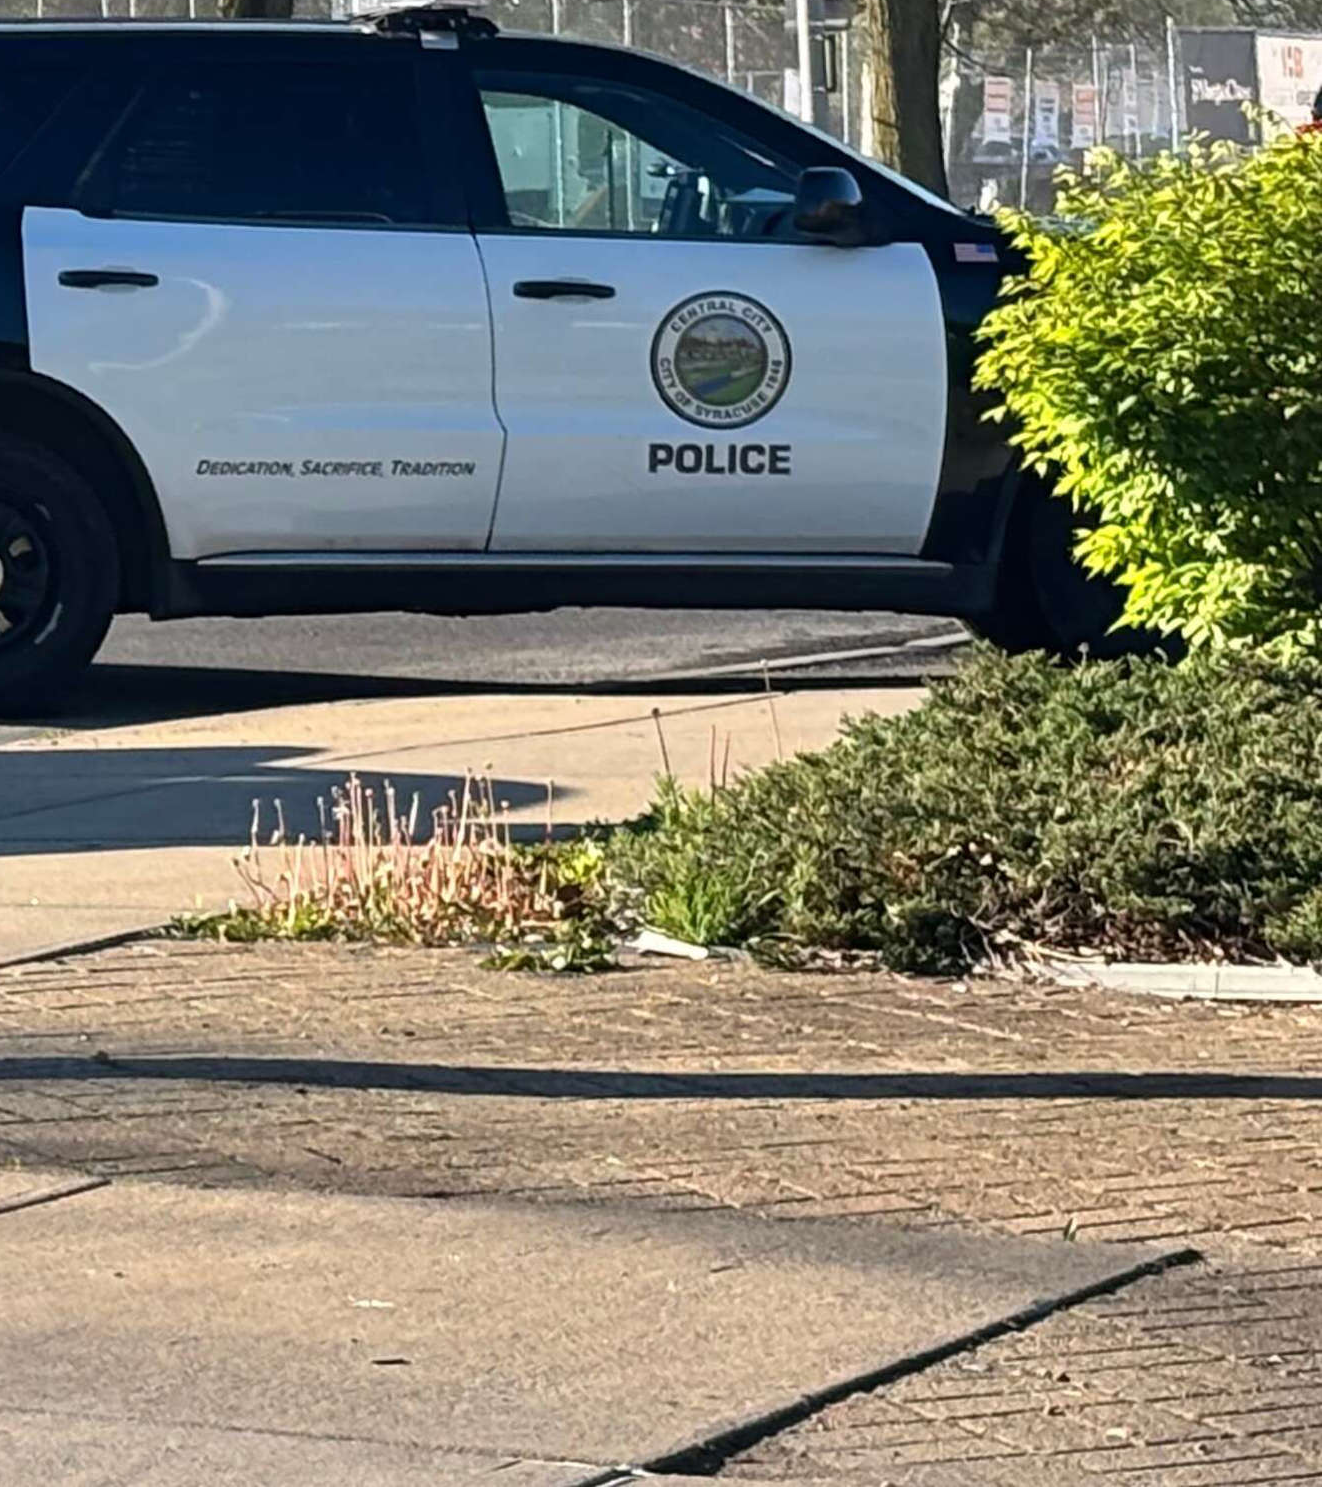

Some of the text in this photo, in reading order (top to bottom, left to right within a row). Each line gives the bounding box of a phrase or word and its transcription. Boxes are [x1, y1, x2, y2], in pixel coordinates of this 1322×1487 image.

[670, 300, 773, 334] CENTRAL CITY
[659, 357, 677, 389] CITY
[674, 390, 693, 407] OF
[695, 392, 769, 420] SYRACUSE
[648, 443, 792, 475] POLICE
